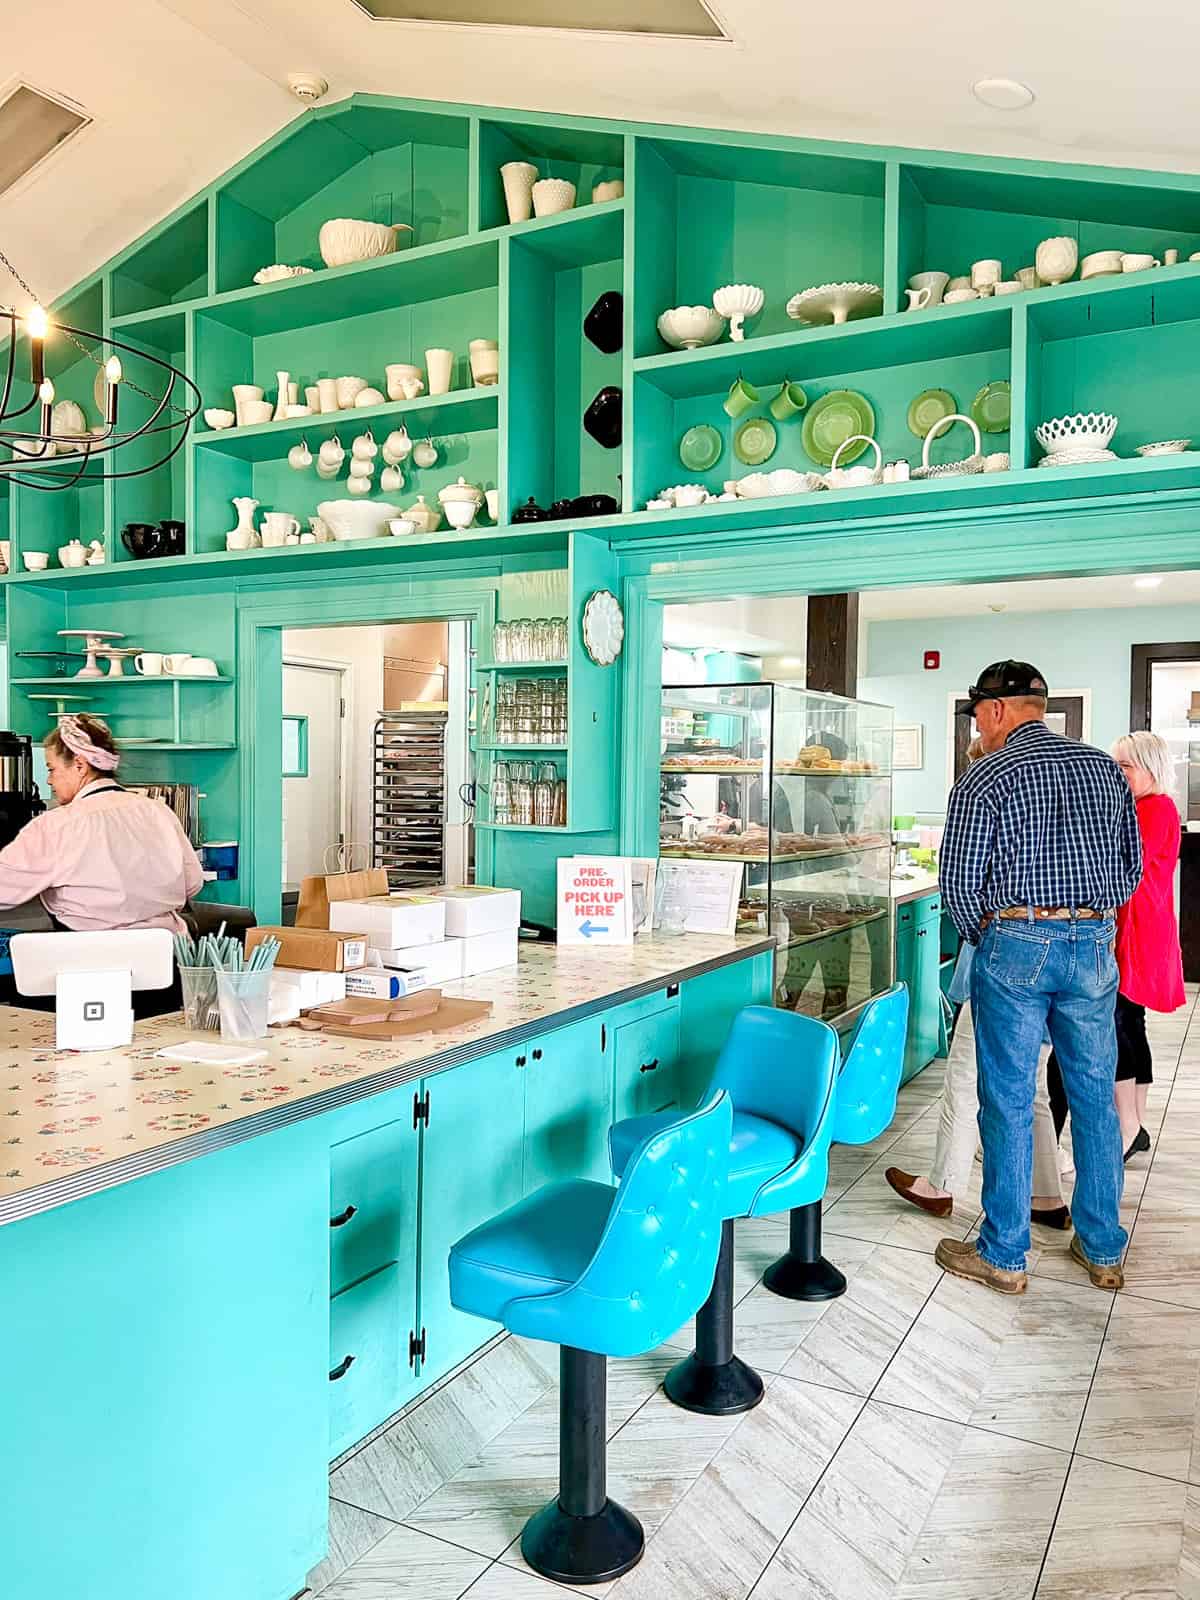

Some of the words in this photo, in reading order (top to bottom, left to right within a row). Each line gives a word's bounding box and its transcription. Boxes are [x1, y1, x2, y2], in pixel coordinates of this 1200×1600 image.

[579, 867, 608, 877] PRE-
[573, 878, 614, 887] ORDER
[565, 892, 601, 903] PICK
[603, 892, 624, 903] UP
[575, 905, 615, 916] HERE
